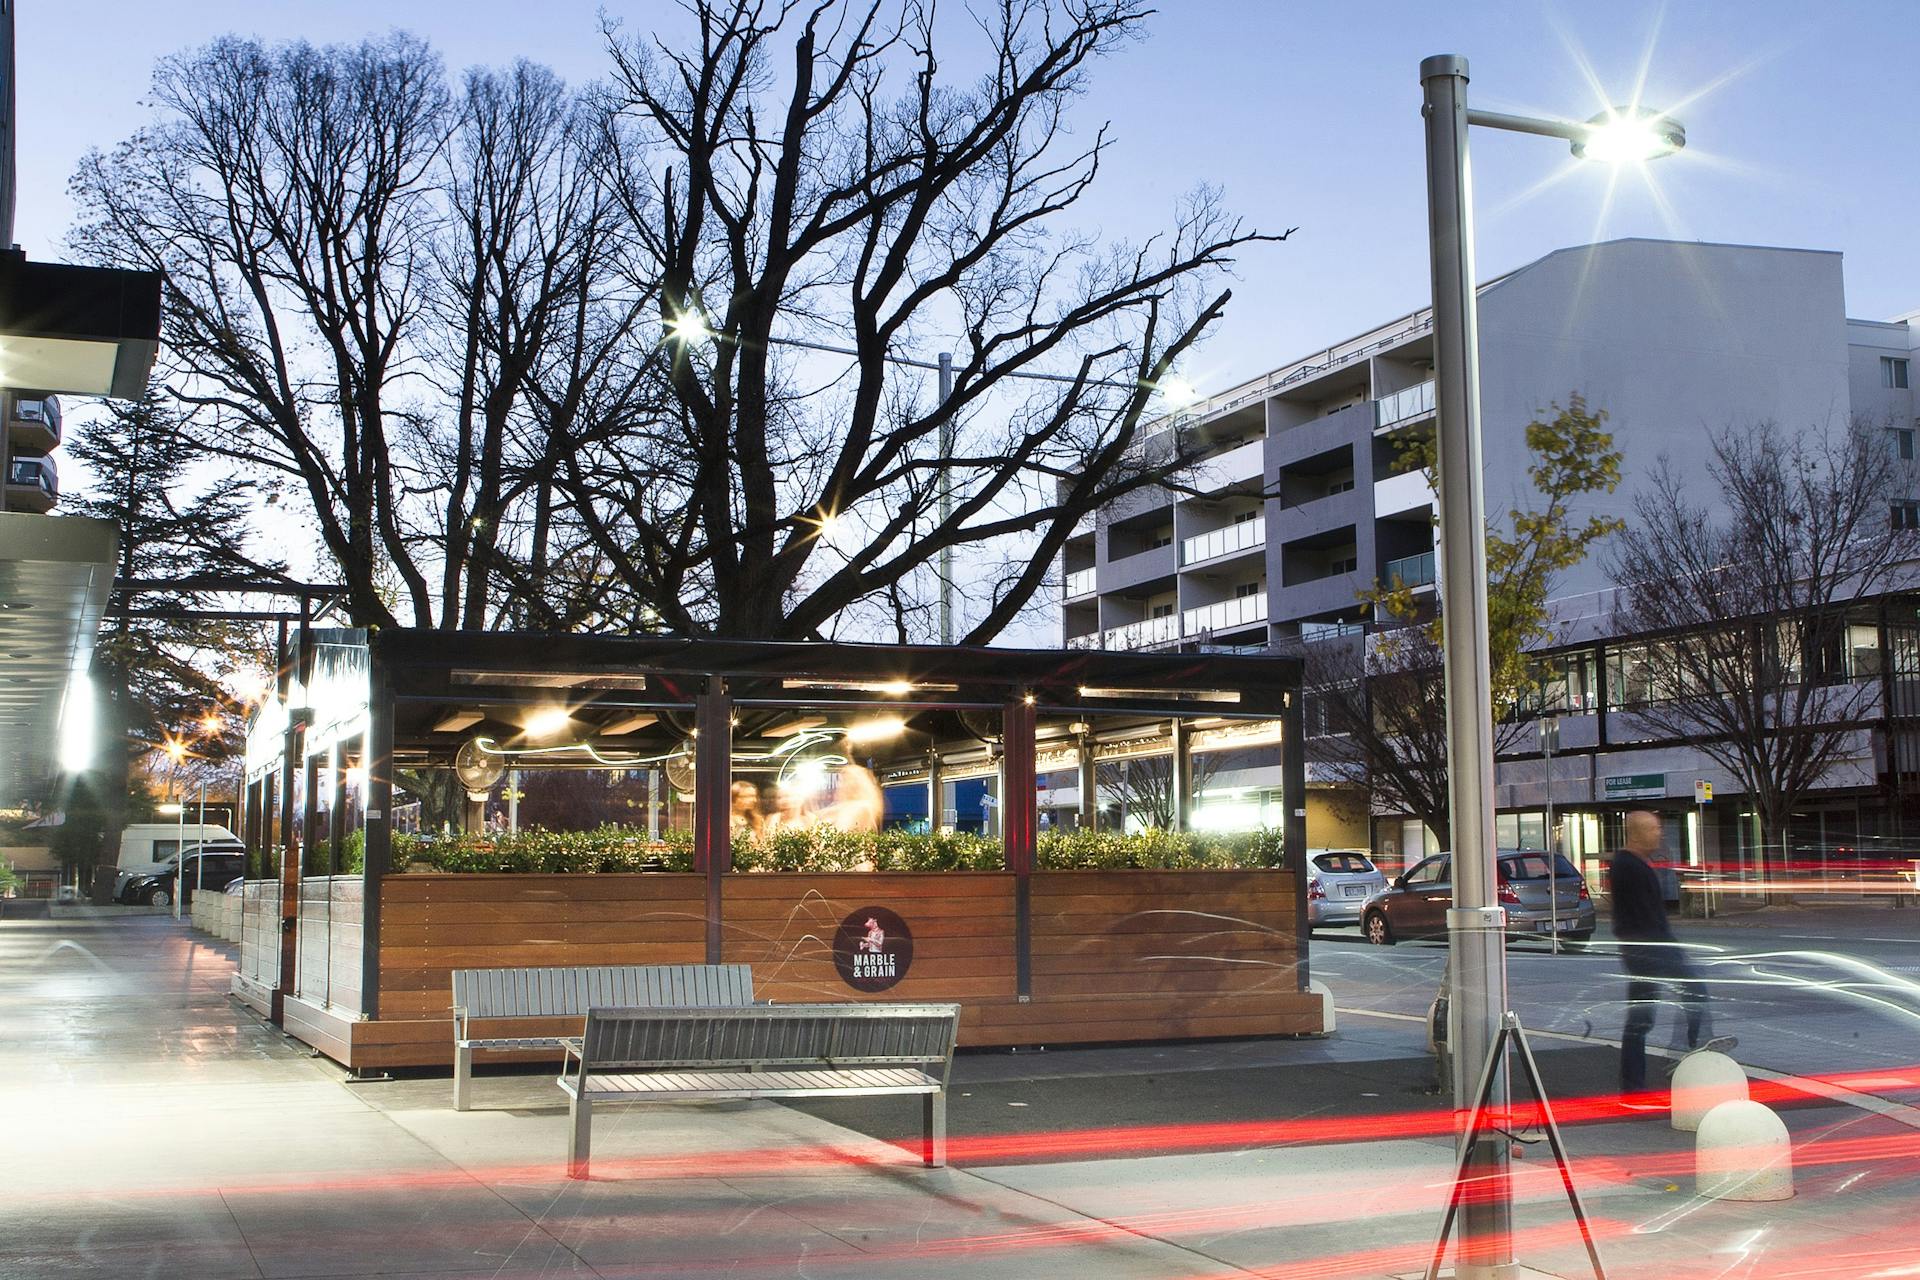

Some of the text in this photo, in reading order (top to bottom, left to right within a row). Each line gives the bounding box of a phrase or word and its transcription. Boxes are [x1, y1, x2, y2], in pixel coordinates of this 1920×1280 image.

[1606, 778, 1616, 786] FOR
[853, 954, 895, 966] MARBLE
[853, 966, 895, 977] & GRAIN
